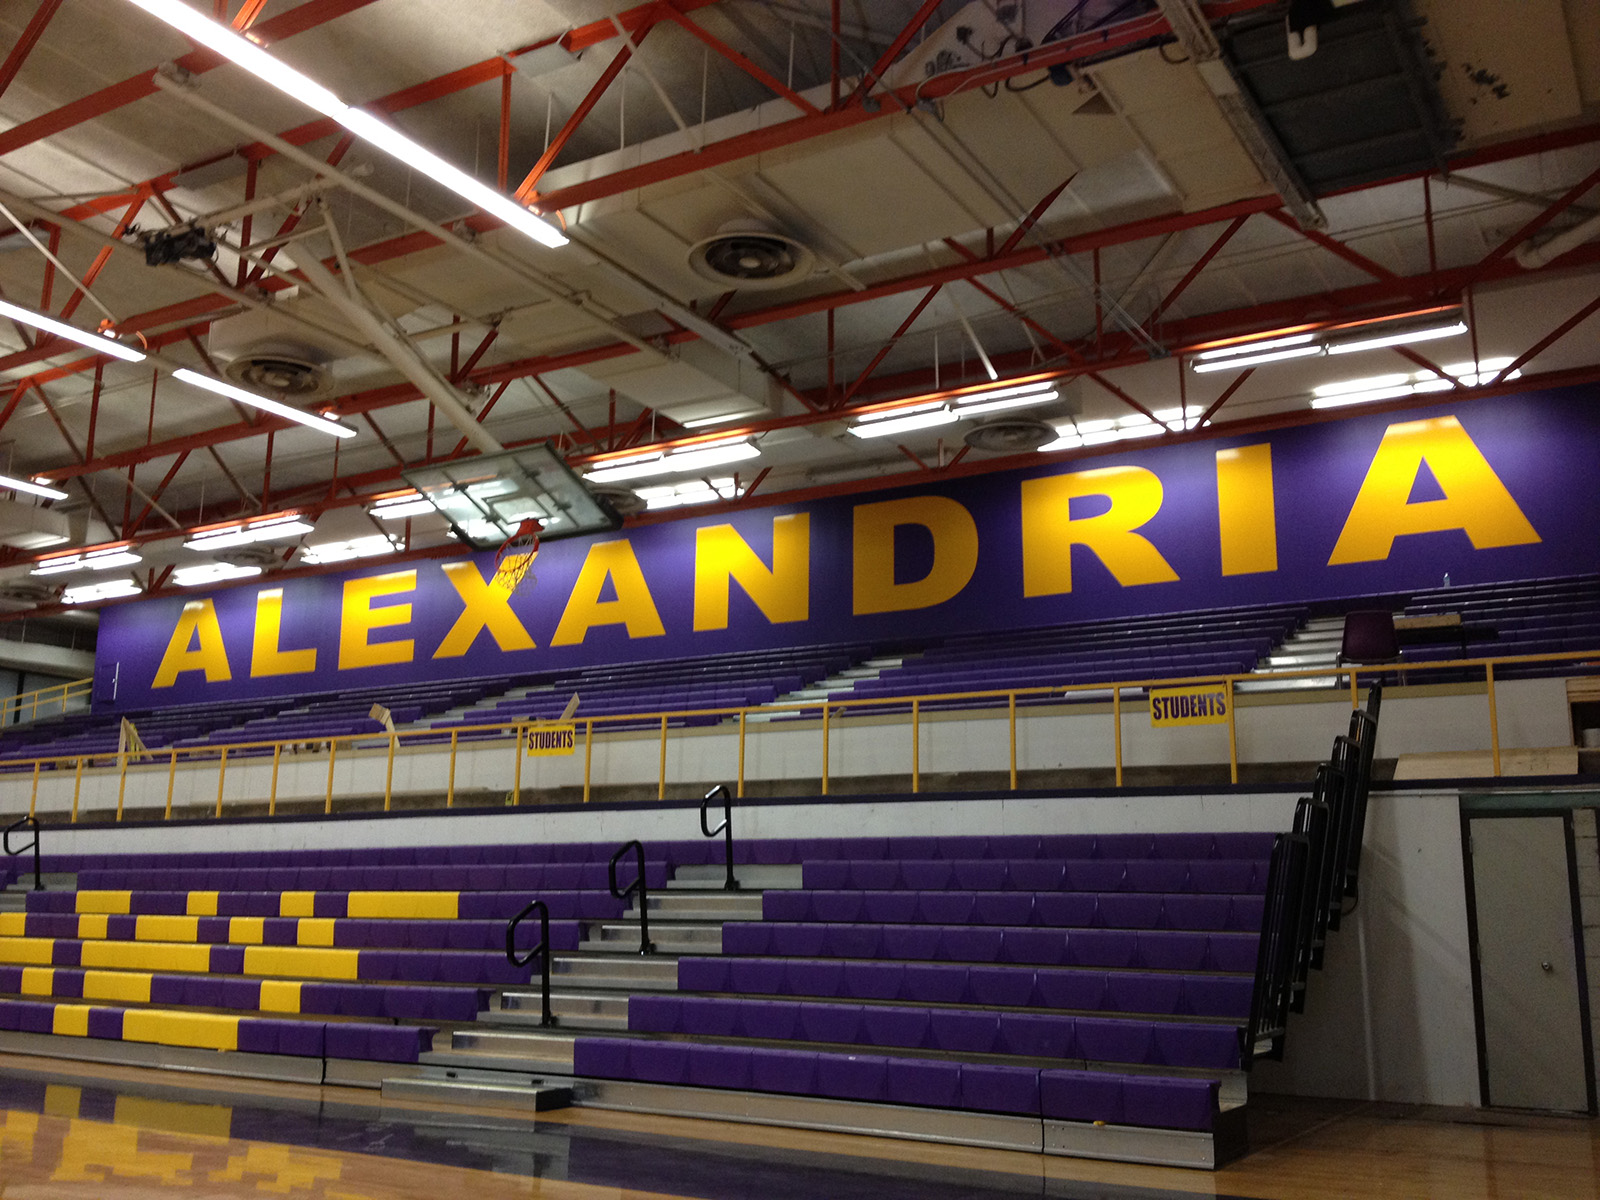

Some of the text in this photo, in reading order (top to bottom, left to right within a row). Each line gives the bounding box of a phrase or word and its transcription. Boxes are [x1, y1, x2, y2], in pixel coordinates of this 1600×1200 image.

[151, 415, 1542, 689] ALEXANDRIA
[1152, 692, 1226, 720] STUDENTS
[528, 730, 573, 749] STUDENTS
